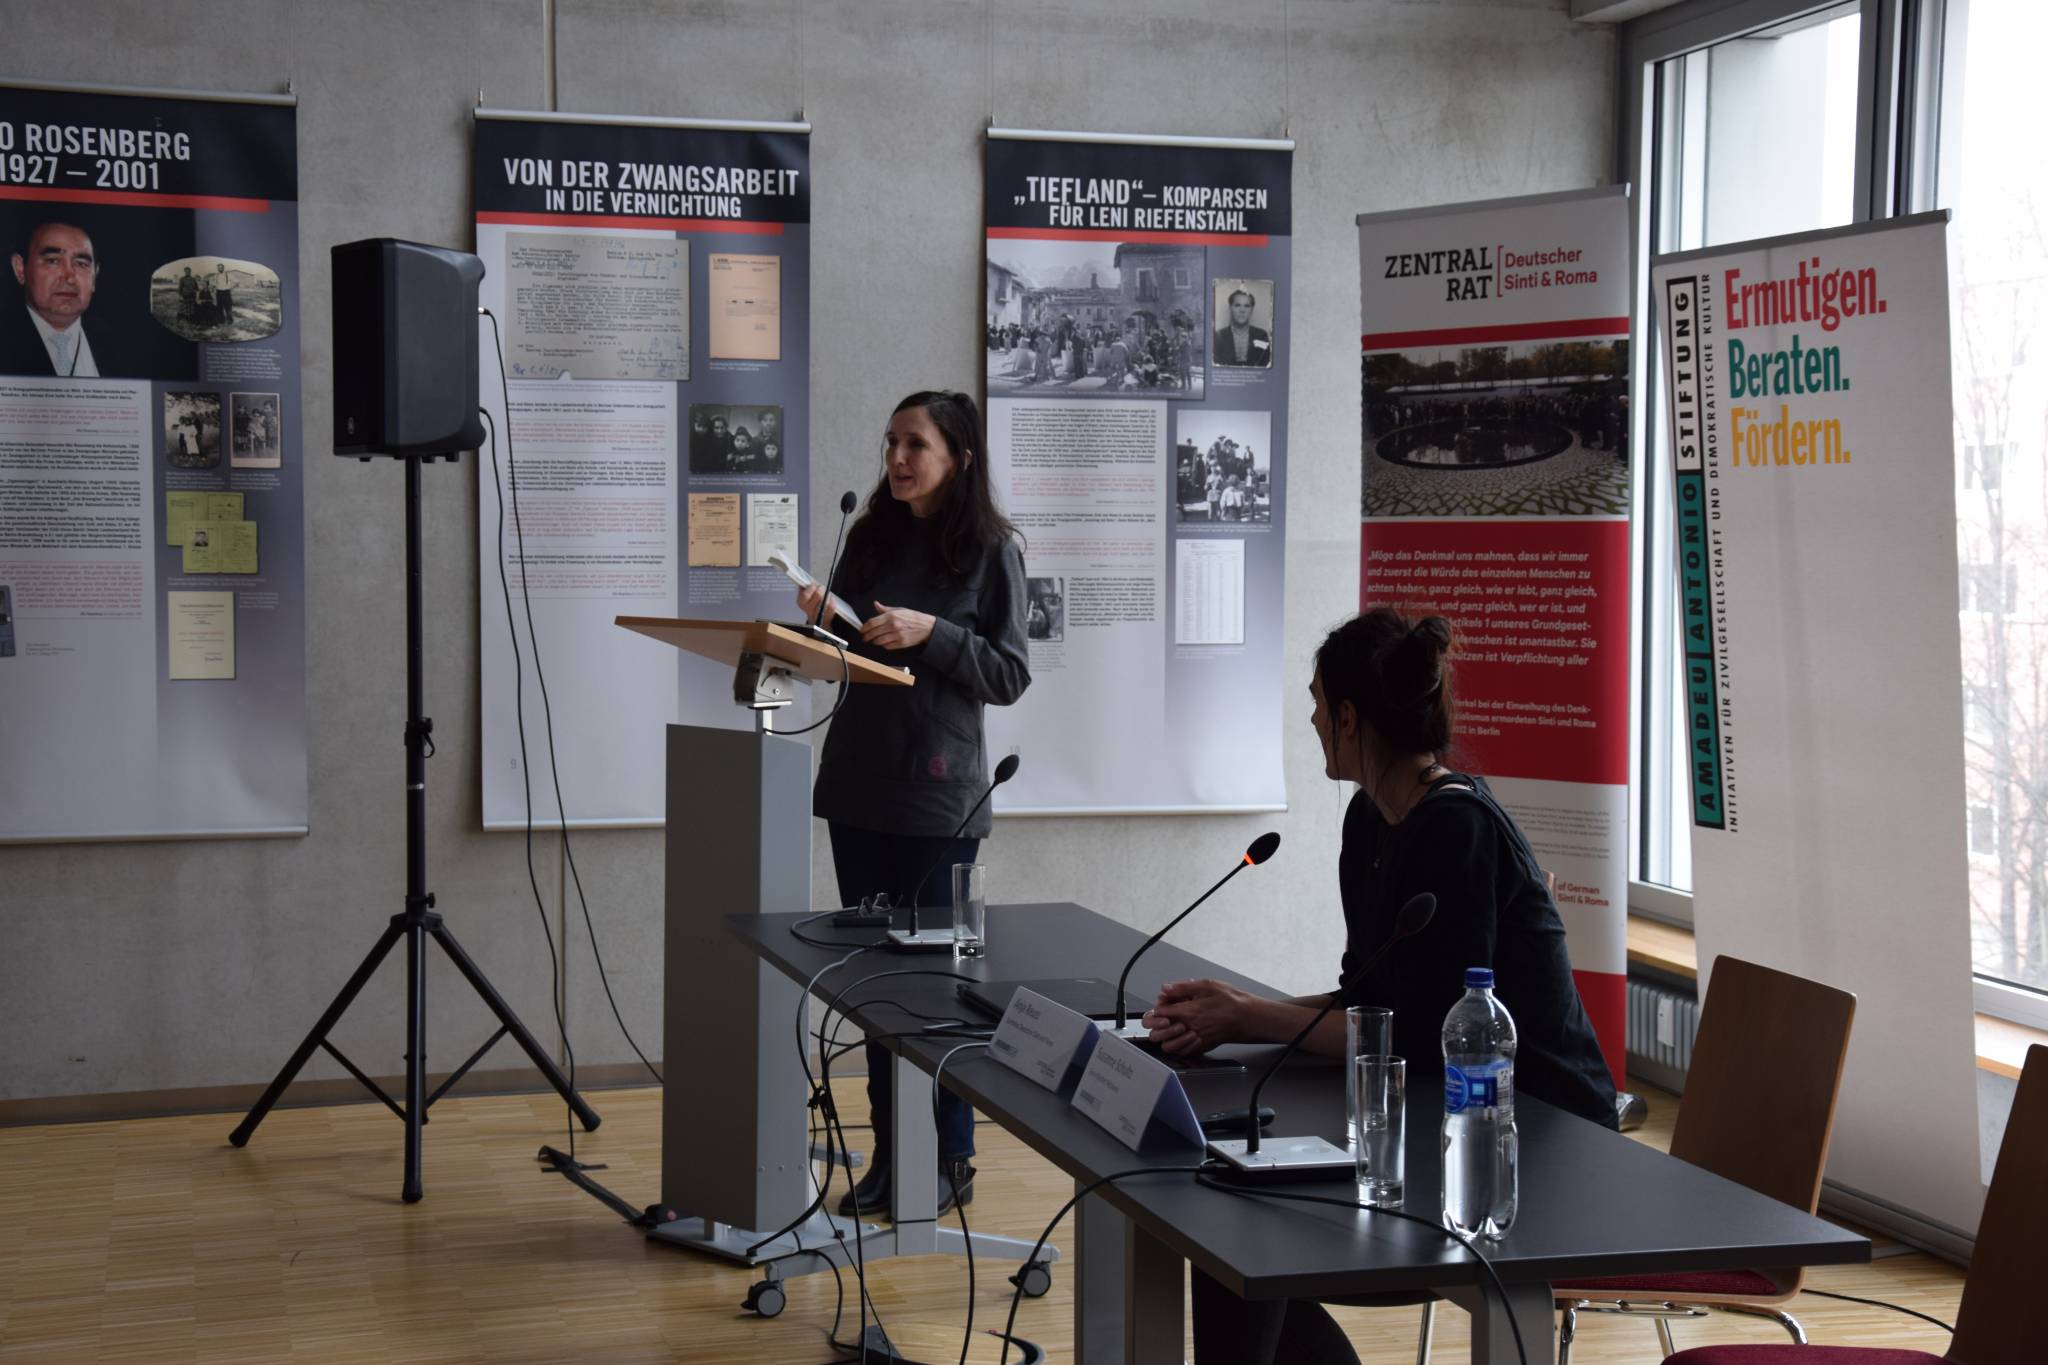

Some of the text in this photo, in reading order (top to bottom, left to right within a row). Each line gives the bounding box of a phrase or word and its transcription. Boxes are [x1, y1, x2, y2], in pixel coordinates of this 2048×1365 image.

[25, 123, 190, 160] ROSENBERG
[0, 153, 58, 184] 1927
[96, 159, 159, 190] 2001
[504, 158, 799, 196] VON DER ZWANGSARBEIT
[546, 189, 741, 218] IN DIE VERNICHTUNG
[1163, 186, 1267, 209] KOMPARSEN
[1050, 201, 1248, 231] FÜR LENI RIEFENSTAHL
[1385, 247, 1493, 279] ZENTRAL
[1504, 247, 1583, 269] Deutscher
[1446, 275, 1493, 301] RAT
[1504, 270, 1598, 290] Sinti & Roma
[1725, 256, 1887, 332] Ermutigen.
[1728, 334, 1850, 398] Beraten.
[1731, 404, 1851, 467] Fördern.
[1395, 550, 1412, 561] das
[1413, 550, 1454, 561] Denkmal
[1455, 552, 1472, 562] uns
[1474, 550, 1516, 563] mahnen,
[1518, 551, 1540, 562] dass
[1542, 552, 1556, 562] wir
[1557, 552, 1589, 562] immer
[1674, 291, 1716, 812] AMADEU ANTONIO STIFTUNG
[1701, 273, 1738, 833] INITIATIVEN FÜR ZIVILGESELLSCHAFT UND DEMOKRATISCHE KULTUR
[1383, 567, 1412, 577] zuerst
[1413, 567, 1429, 577] die
[1430, 566, 1461, 577] Würde
[1462, 567, 1479, 578] des
[1480, 567, 1527, 578] einzelnen
[1529, 567, 1576, 579] Menschen
[1577, 570, 1591, 579] zu
[1429, 585, 1452, 597] ganz
[1453, 584, 1485, 597] gleich,
[1486, 585, 1503, 595] wie
[1504, 587, 1516, 595] er
[1517, 585, 1539, 597] lebt,
[1539, 587, 1563, 598] ganz
[1564, 586, 1598, 599] gleich,
[1441, 601, 1459, 611] und
[1460, 602, 1484, 613] ganz
[1484, 601, 1517, 614] gleich,
[1519, 604, 1536, 613] wer
[1538, 605, 1550, 613] er
[1567, 603, 1587, 614] und
[1485, 618, 1490, 628] 1
[1491, 619, 1530, 629] unseres
[1531, 619, 1592, 632] Grundgeset-
[1455, 634, 1597, 649] Menschen ist unantastbar. Sie
[1485, 651, 1498, 662] ist
[1500, 652, 1566, 667] Verpflichtung
[1566, 653, 1589, 666] aller
[1478, 699, 1490, 709] bei
[1491, 700, 1505, 710] der
[1551, 702, 1566, 713] des
[1477, 725, 1501, 736] Berlin
[1557, 717, 1572, 727] und
[1572, 718, 1597, 729] Roma
[1567, 883, 1600, 895] German
[1585, 896, 1609, 907] Roma
